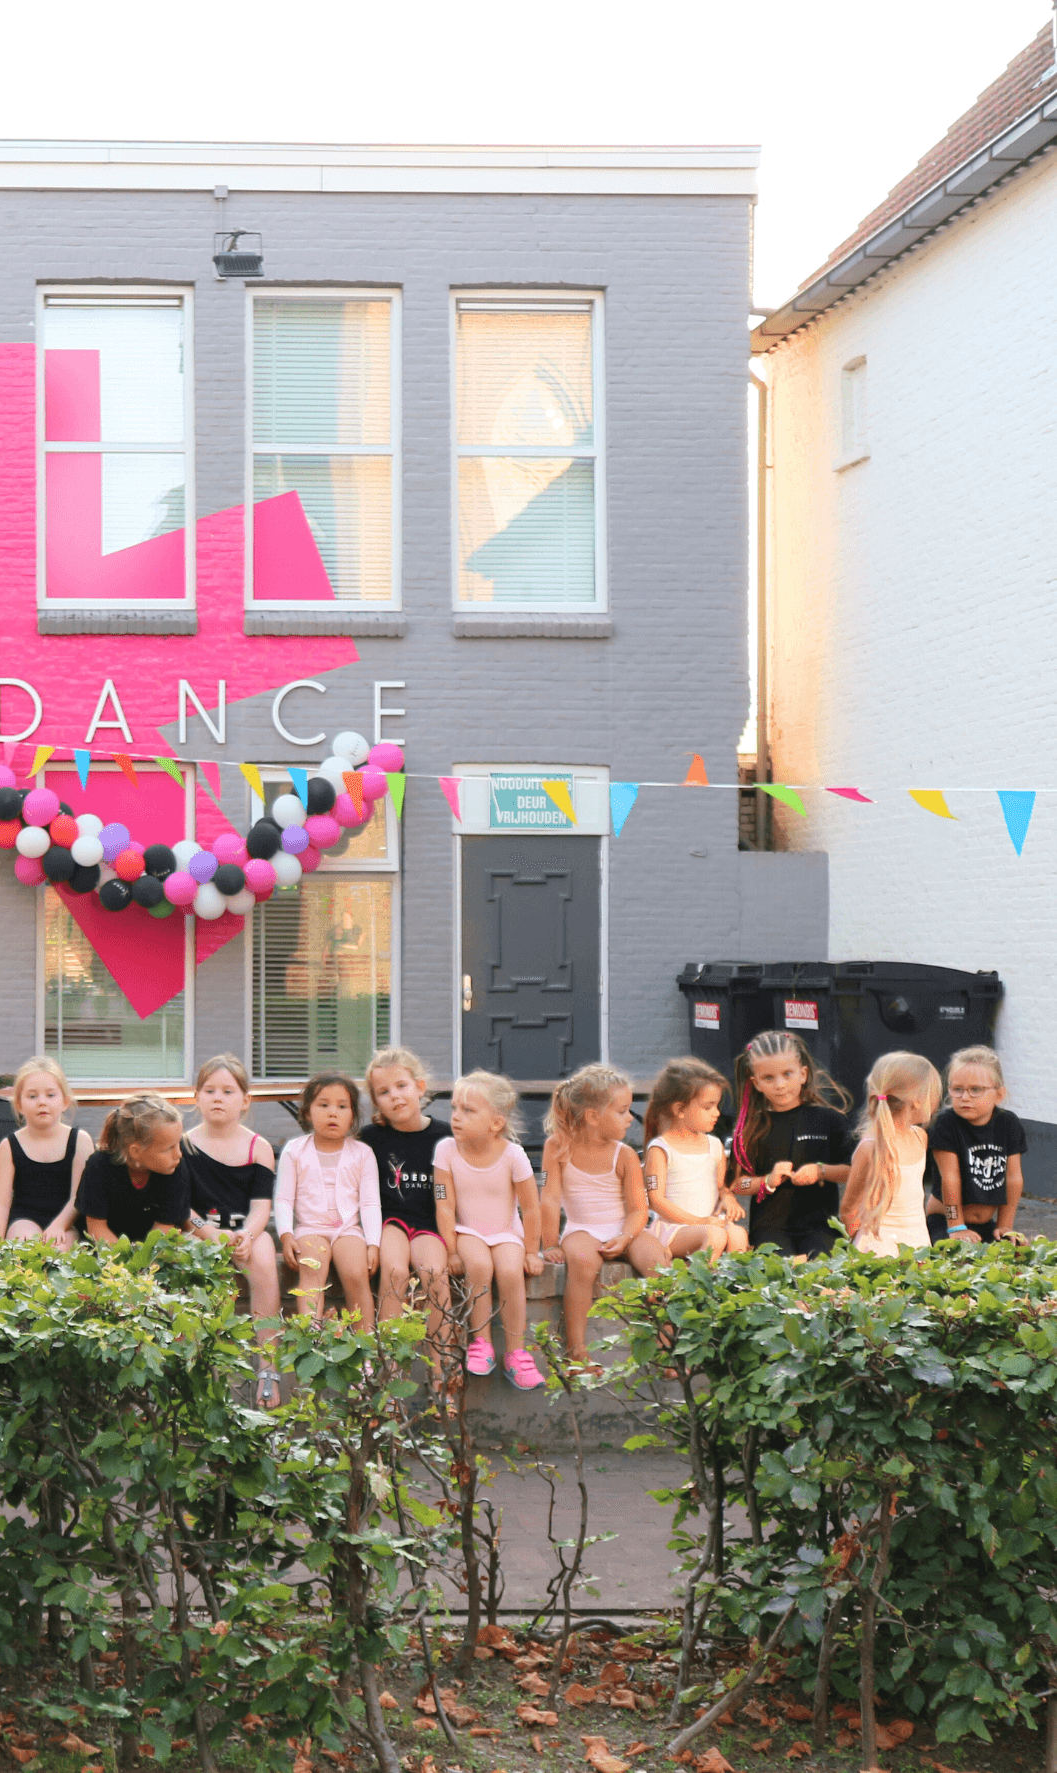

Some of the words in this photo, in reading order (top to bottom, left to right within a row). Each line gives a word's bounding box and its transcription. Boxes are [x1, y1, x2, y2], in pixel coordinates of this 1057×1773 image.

[517, 795, 546, 809] DEUR
[496, 811, 566, 824] VRIJHOUDEN
[436, 1191, 446, 1199] DE
